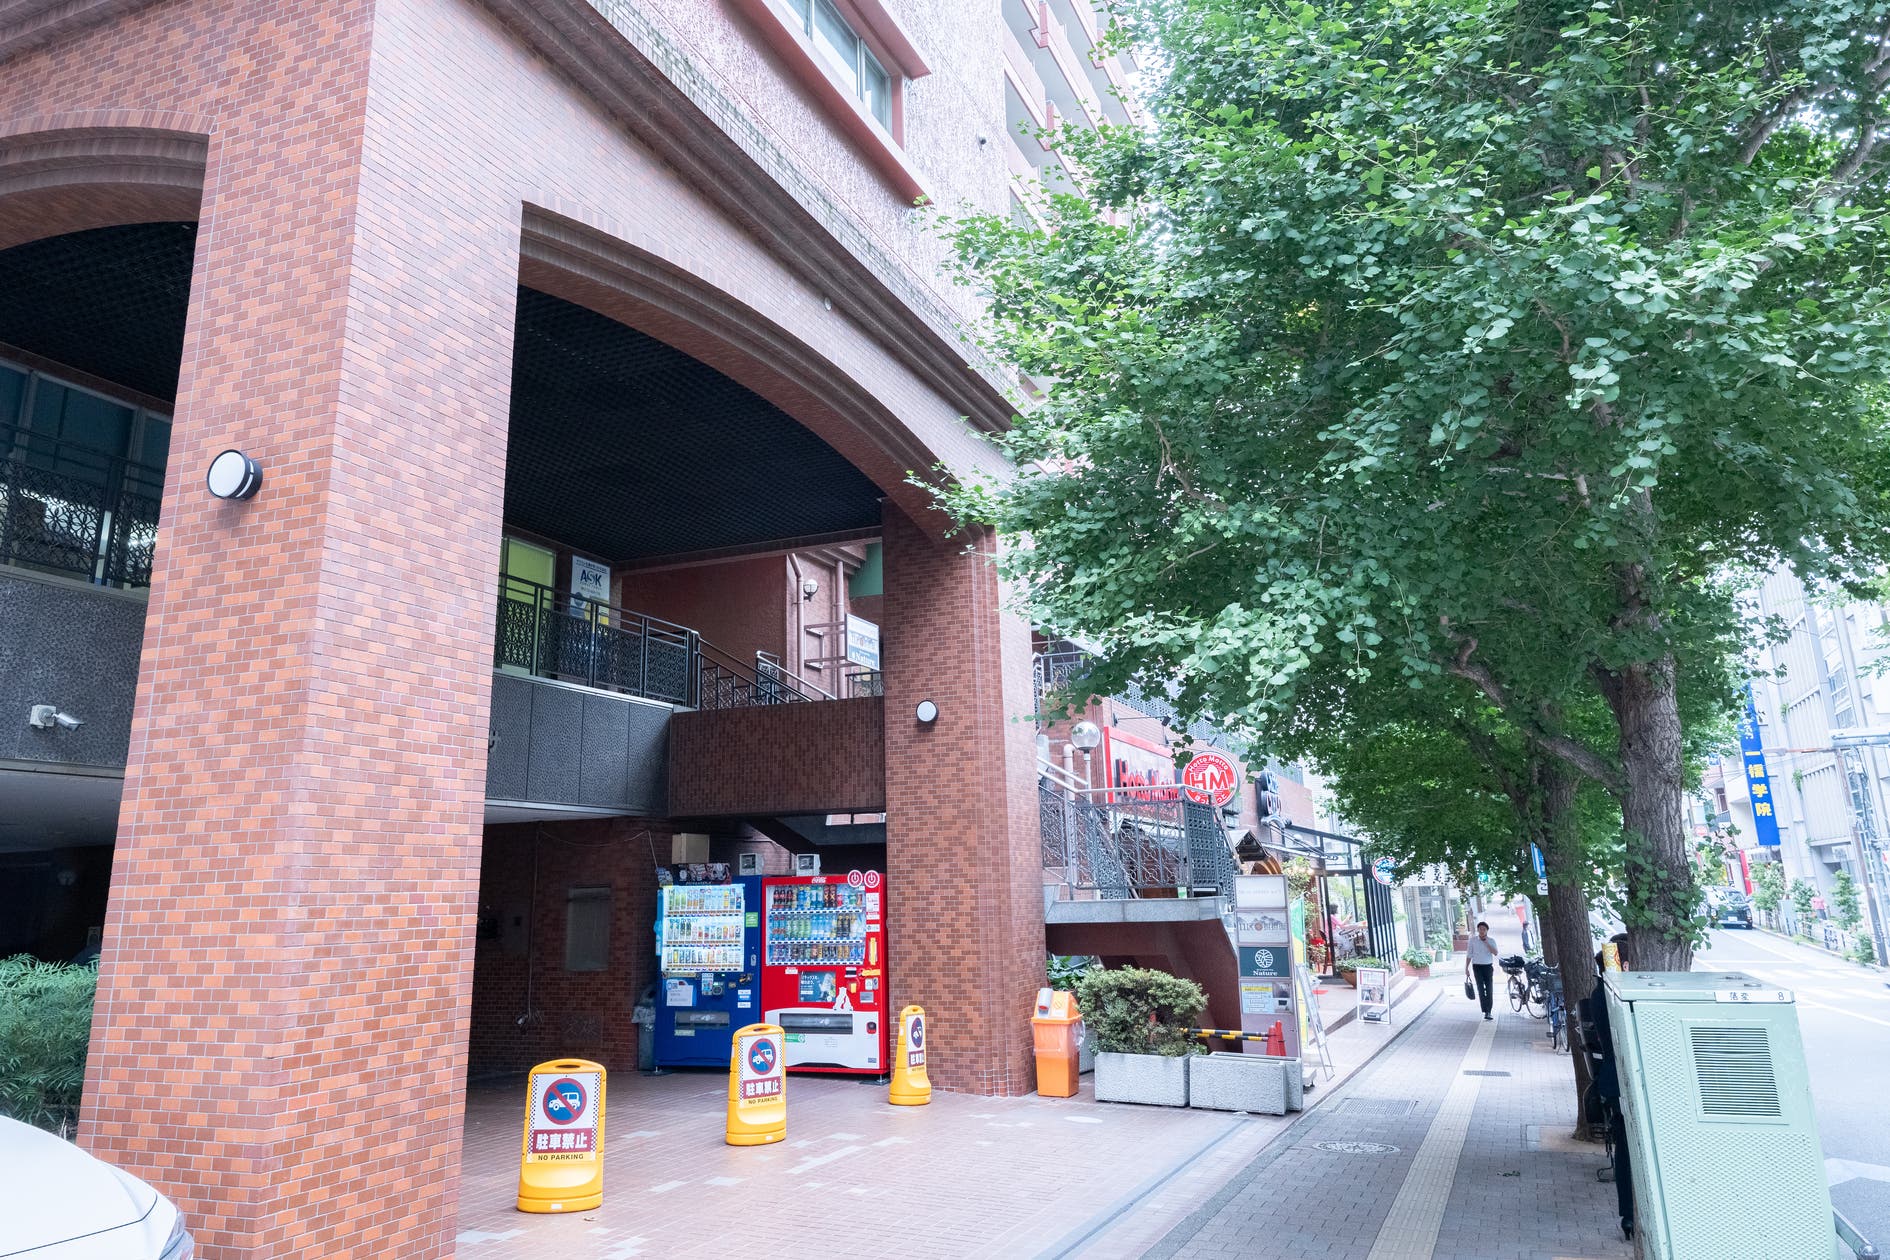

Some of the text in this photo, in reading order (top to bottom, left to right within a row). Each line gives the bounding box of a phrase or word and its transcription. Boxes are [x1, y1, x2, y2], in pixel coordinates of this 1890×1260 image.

[580, 569, 602, 587] ASK
[1188, 754, 1229, 773] Hotto Motto
[1190, 770, 1229, 791] HM
[745, 1080, 779, 1096] 駐車禁止
[536, 1132, 588, 1150] 駐車禁止
